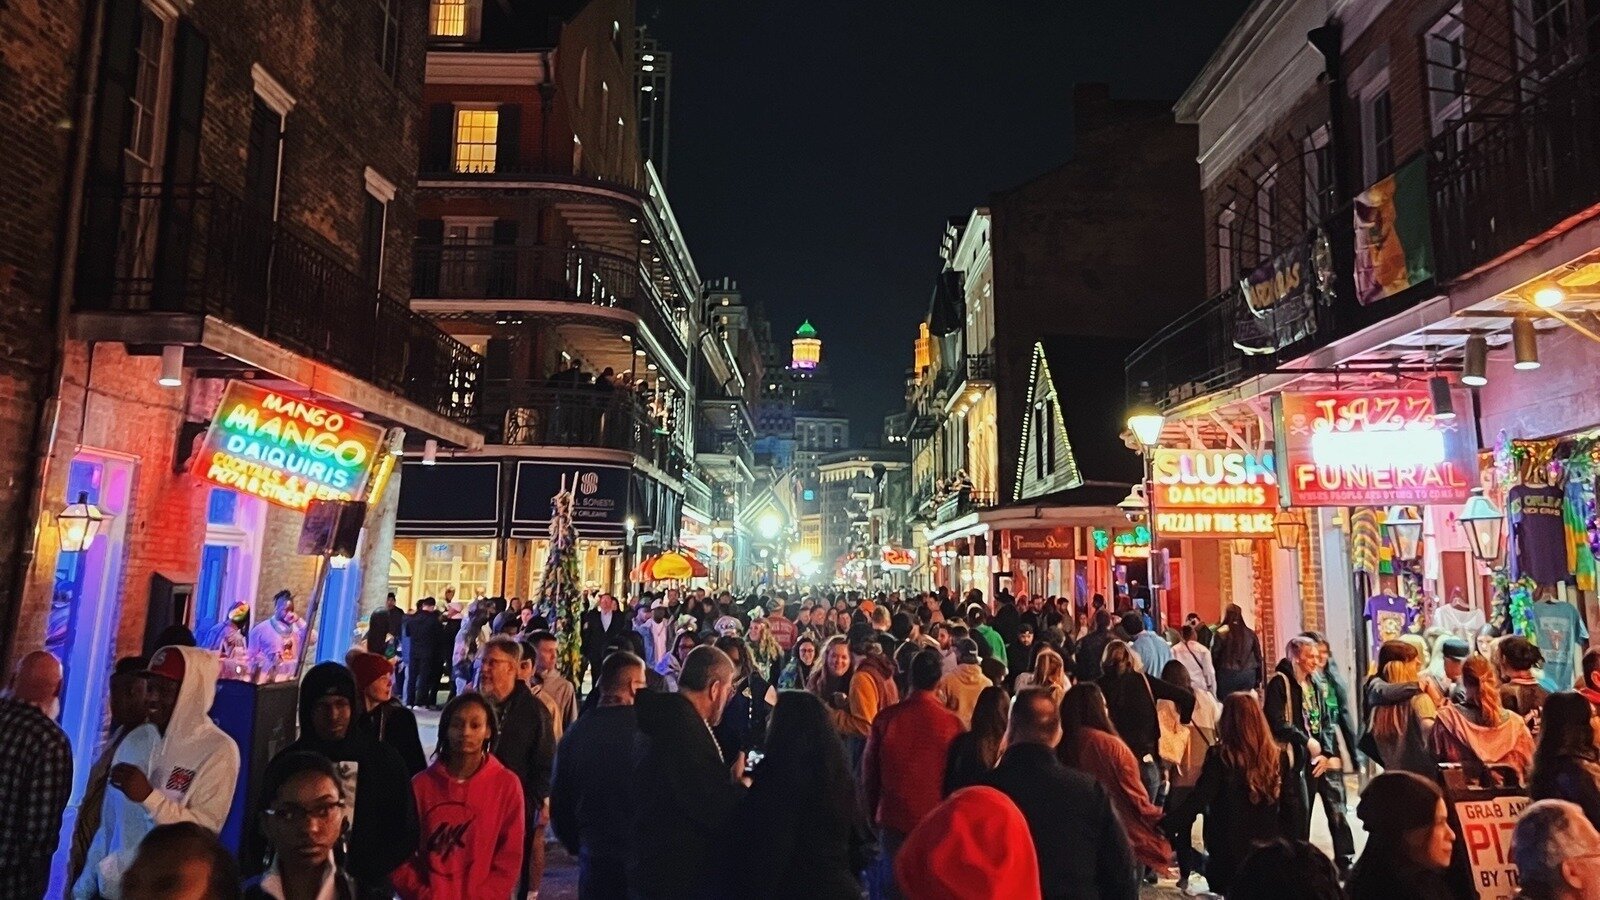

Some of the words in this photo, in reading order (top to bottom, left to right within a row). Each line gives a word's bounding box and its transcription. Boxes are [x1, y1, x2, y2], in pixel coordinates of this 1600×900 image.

[262, 393, 344, 432] MANGO
[1310, 396, 1436, 433] JAZZ
[224, 403, 367, 467] MANGO
[227, 434, 350, 488] DAIQUIRIS
[1157, 453, 1276, 485] SLUSH
[1296, 461, 1468, 491] FUNERAL
[1168, 486, 1265, 505] DAIQUIRIS
[1157, 513, 1194, 532] PIZZA
[1194, 513, 1213, 532] BY
[1238, 513, 1275, 533] SLICE
[1465, 804, 1503, 819] GRAB
[1508, 801, 1529, 818] AN
[1480, 870, 1498, 888] BY
